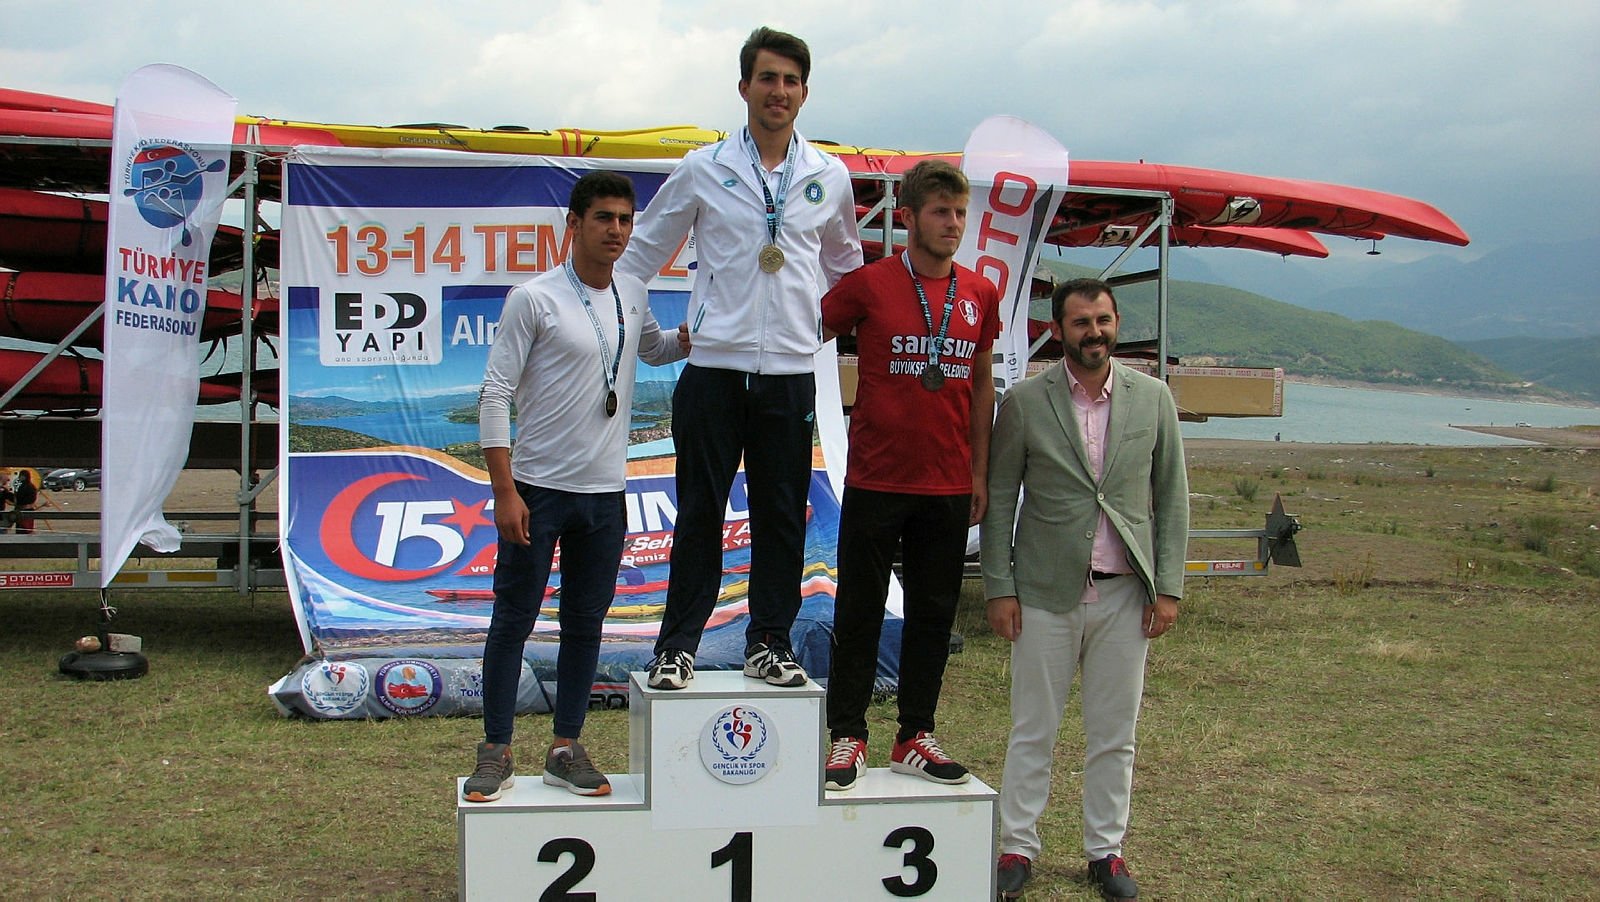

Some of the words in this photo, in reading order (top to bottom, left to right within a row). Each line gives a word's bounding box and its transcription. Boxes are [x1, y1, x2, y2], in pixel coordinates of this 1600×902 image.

[118, 246, 206, 284] TÜRKİYE
[325, 222, 467, 276] 13-14
[117, 276, 201, 314] KANO
[334, 292, 428, 330] EDD
[336, 332, 424, 353] YAPI
[372, 500, 466, 568] 15
[537, 836, 597, 902] 2
[710, 831, 754, 902] 1
[881, 825, 939, 898] 3
